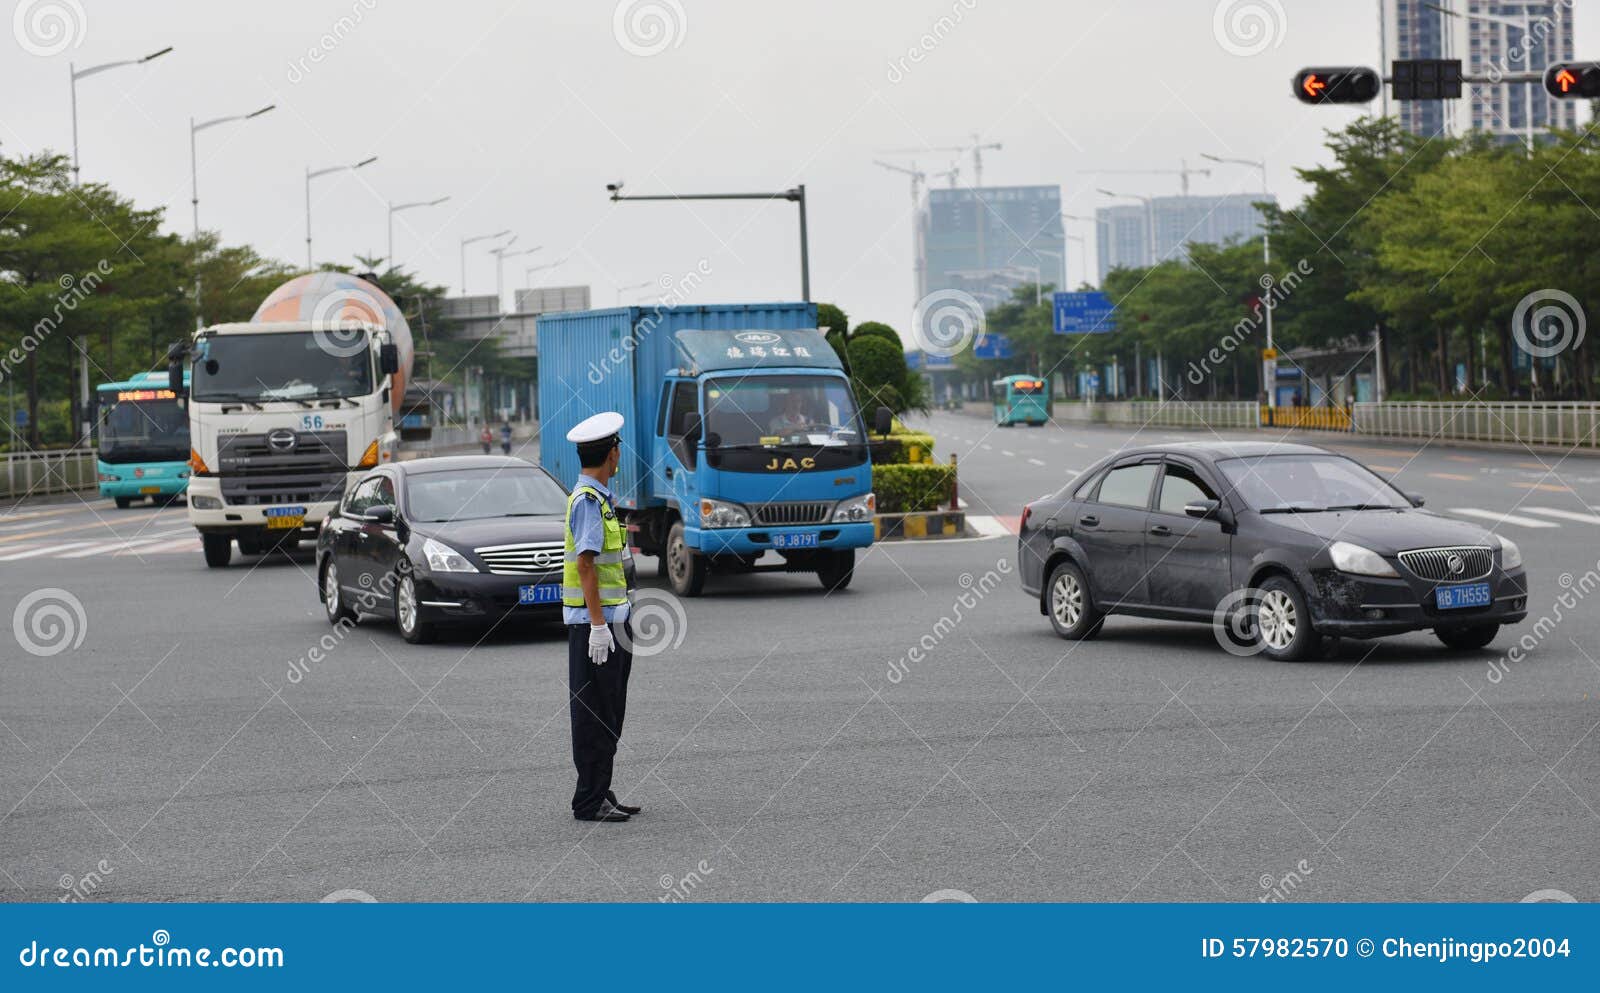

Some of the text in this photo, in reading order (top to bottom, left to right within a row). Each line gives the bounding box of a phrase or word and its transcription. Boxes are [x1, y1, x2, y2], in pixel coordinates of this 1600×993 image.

[303, 416, 322, 430] 56
[766, 457, 816, 470] JAC
[1456, 586, 1489, 604] 7H555
